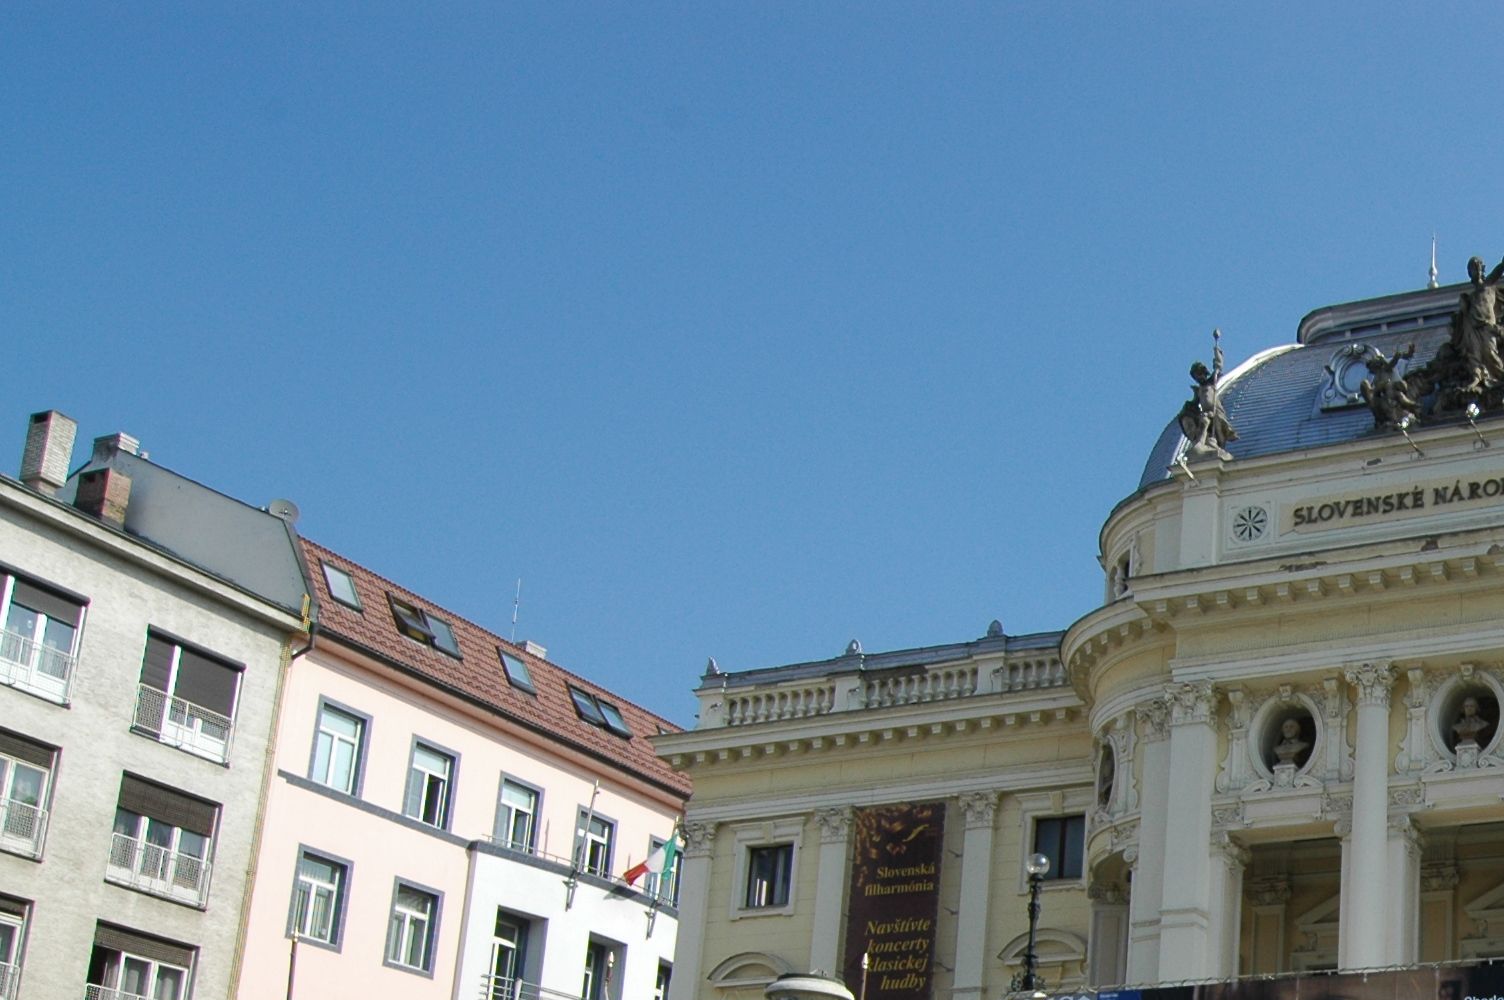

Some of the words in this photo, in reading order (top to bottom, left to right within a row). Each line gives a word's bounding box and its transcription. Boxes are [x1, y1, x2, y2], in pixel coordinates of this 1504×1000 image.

[1293, 485, 1425, 527] SLOVENSKÉ
[876, 863, 935, 879] Slovenská
[864, 880, 934, 896] filharmónia
[864, 917, 931, 935] Navštívte
[866, 937, 930, 954] koncerty
[880, 974, 926, 992] hudby
